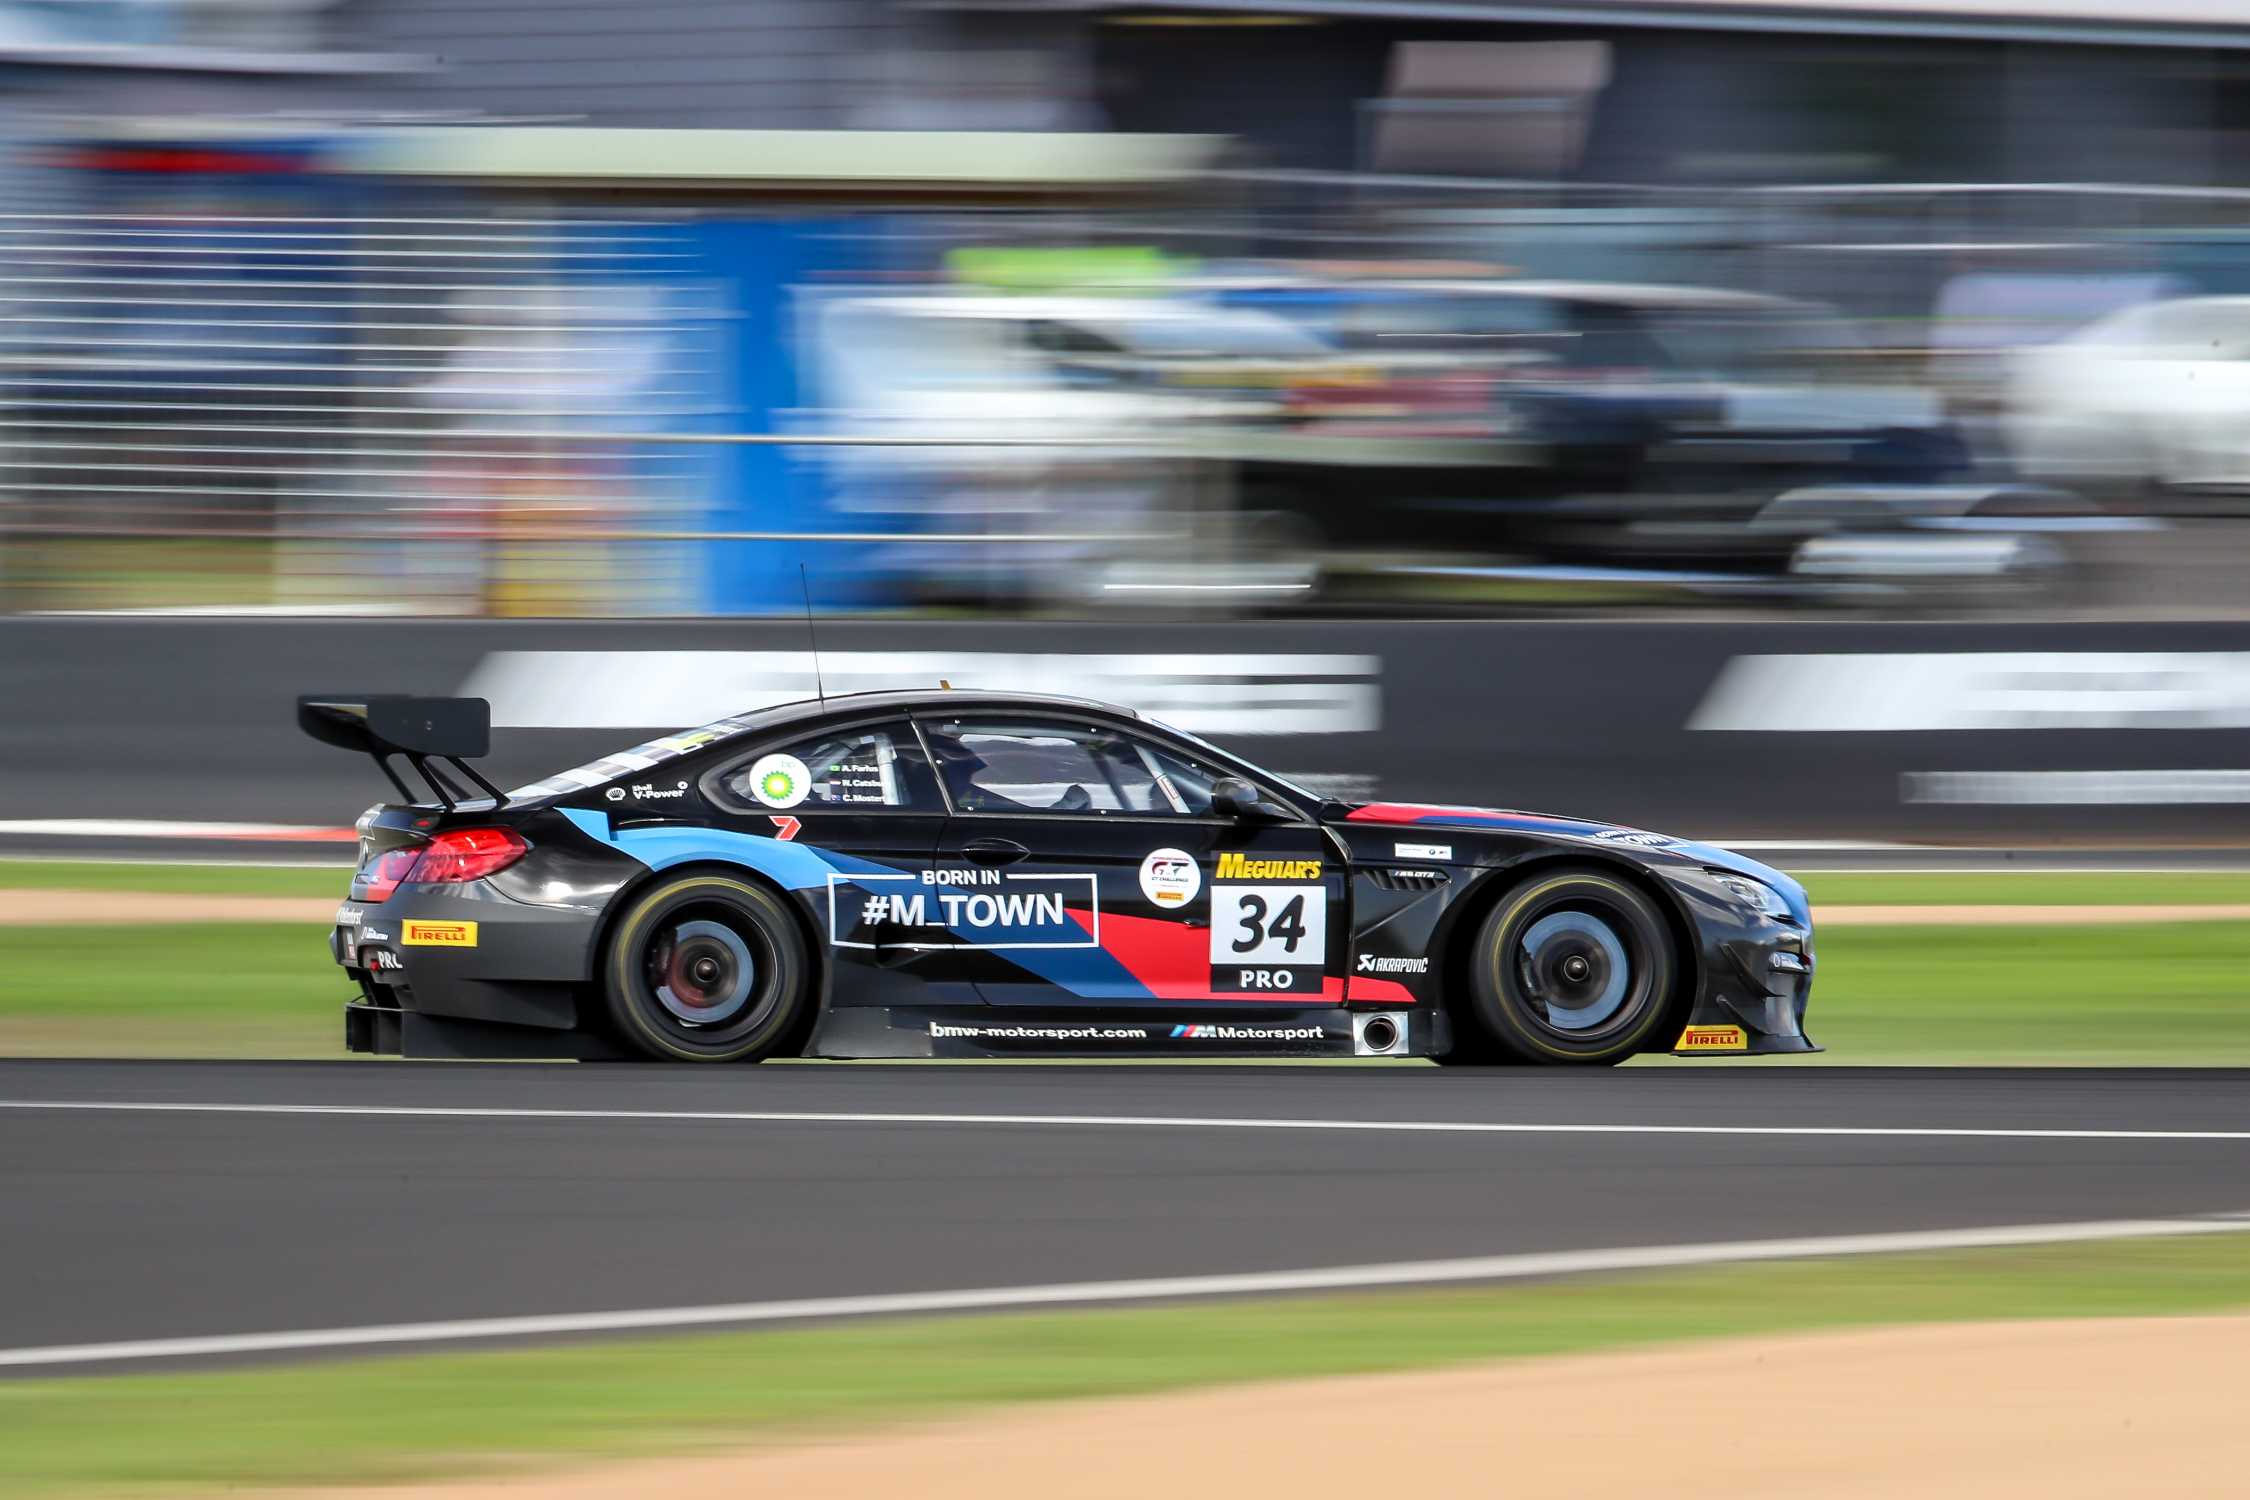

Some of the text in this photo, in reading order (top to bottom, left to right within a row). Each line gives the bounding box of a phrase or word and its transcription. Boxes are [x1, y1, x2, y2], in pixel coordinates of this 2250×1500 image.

[632, 784, 653, 792] Shell
[632, 790, 684, 800] V-Power
[921, 869, 1001, 886] BORN IN
[861, 892, 1064, 928] #M_TOWN
[1231, 893, 1306, 954] 34
[411, 925, 466, 942] PIRELLI
[1239, 969, 1294, 989] PRO
[928, 1021, 1148, 1041] bmw-motorsport.com
[1217, 1026, 1325, 1040] Motorsport
[1685, 1030, 1739, 1045] PIRELLI
